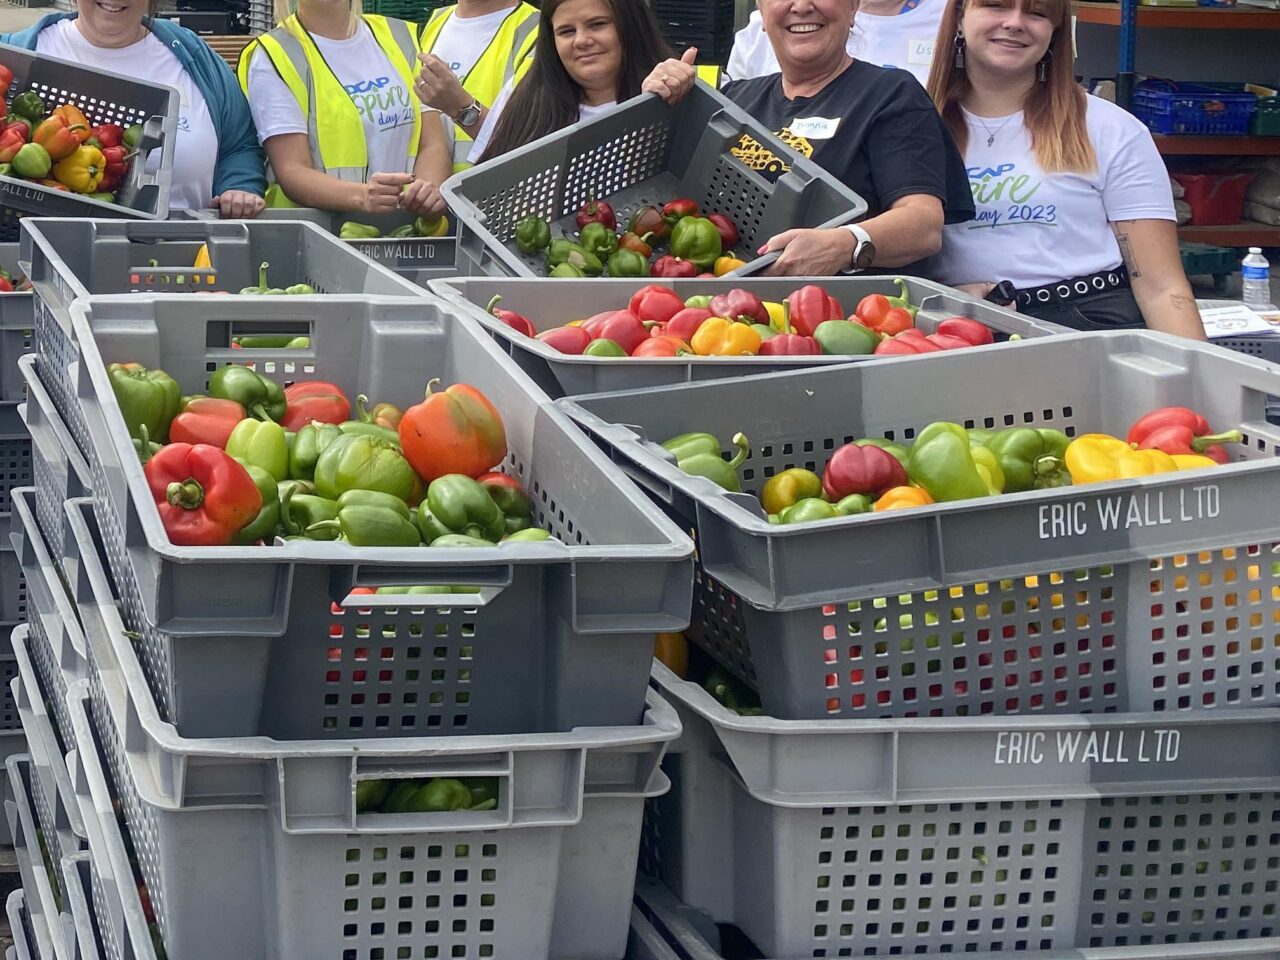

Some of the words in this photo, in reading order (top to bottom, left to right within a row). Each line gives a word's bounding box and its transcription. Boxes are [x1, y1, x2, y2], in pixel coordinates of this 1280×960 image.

[378, 113, 399, 129] day
[1007, 204, 1057, 222] 2023
[360, 244, 381, 259] ERIC
[383, 243, 415, 259] WALL
[417, 243, 436, 259] LTD
[1038, 501, 1087, 539] ERIC
[1096, 491, 1172, 531] WALL
[1180, 485, 1220, 522] LTD
[994, 731, 1046, 764] ERIC
[1056, 730, 1129, 763] WALL
[1138, 729, 1181, 762] LTD
